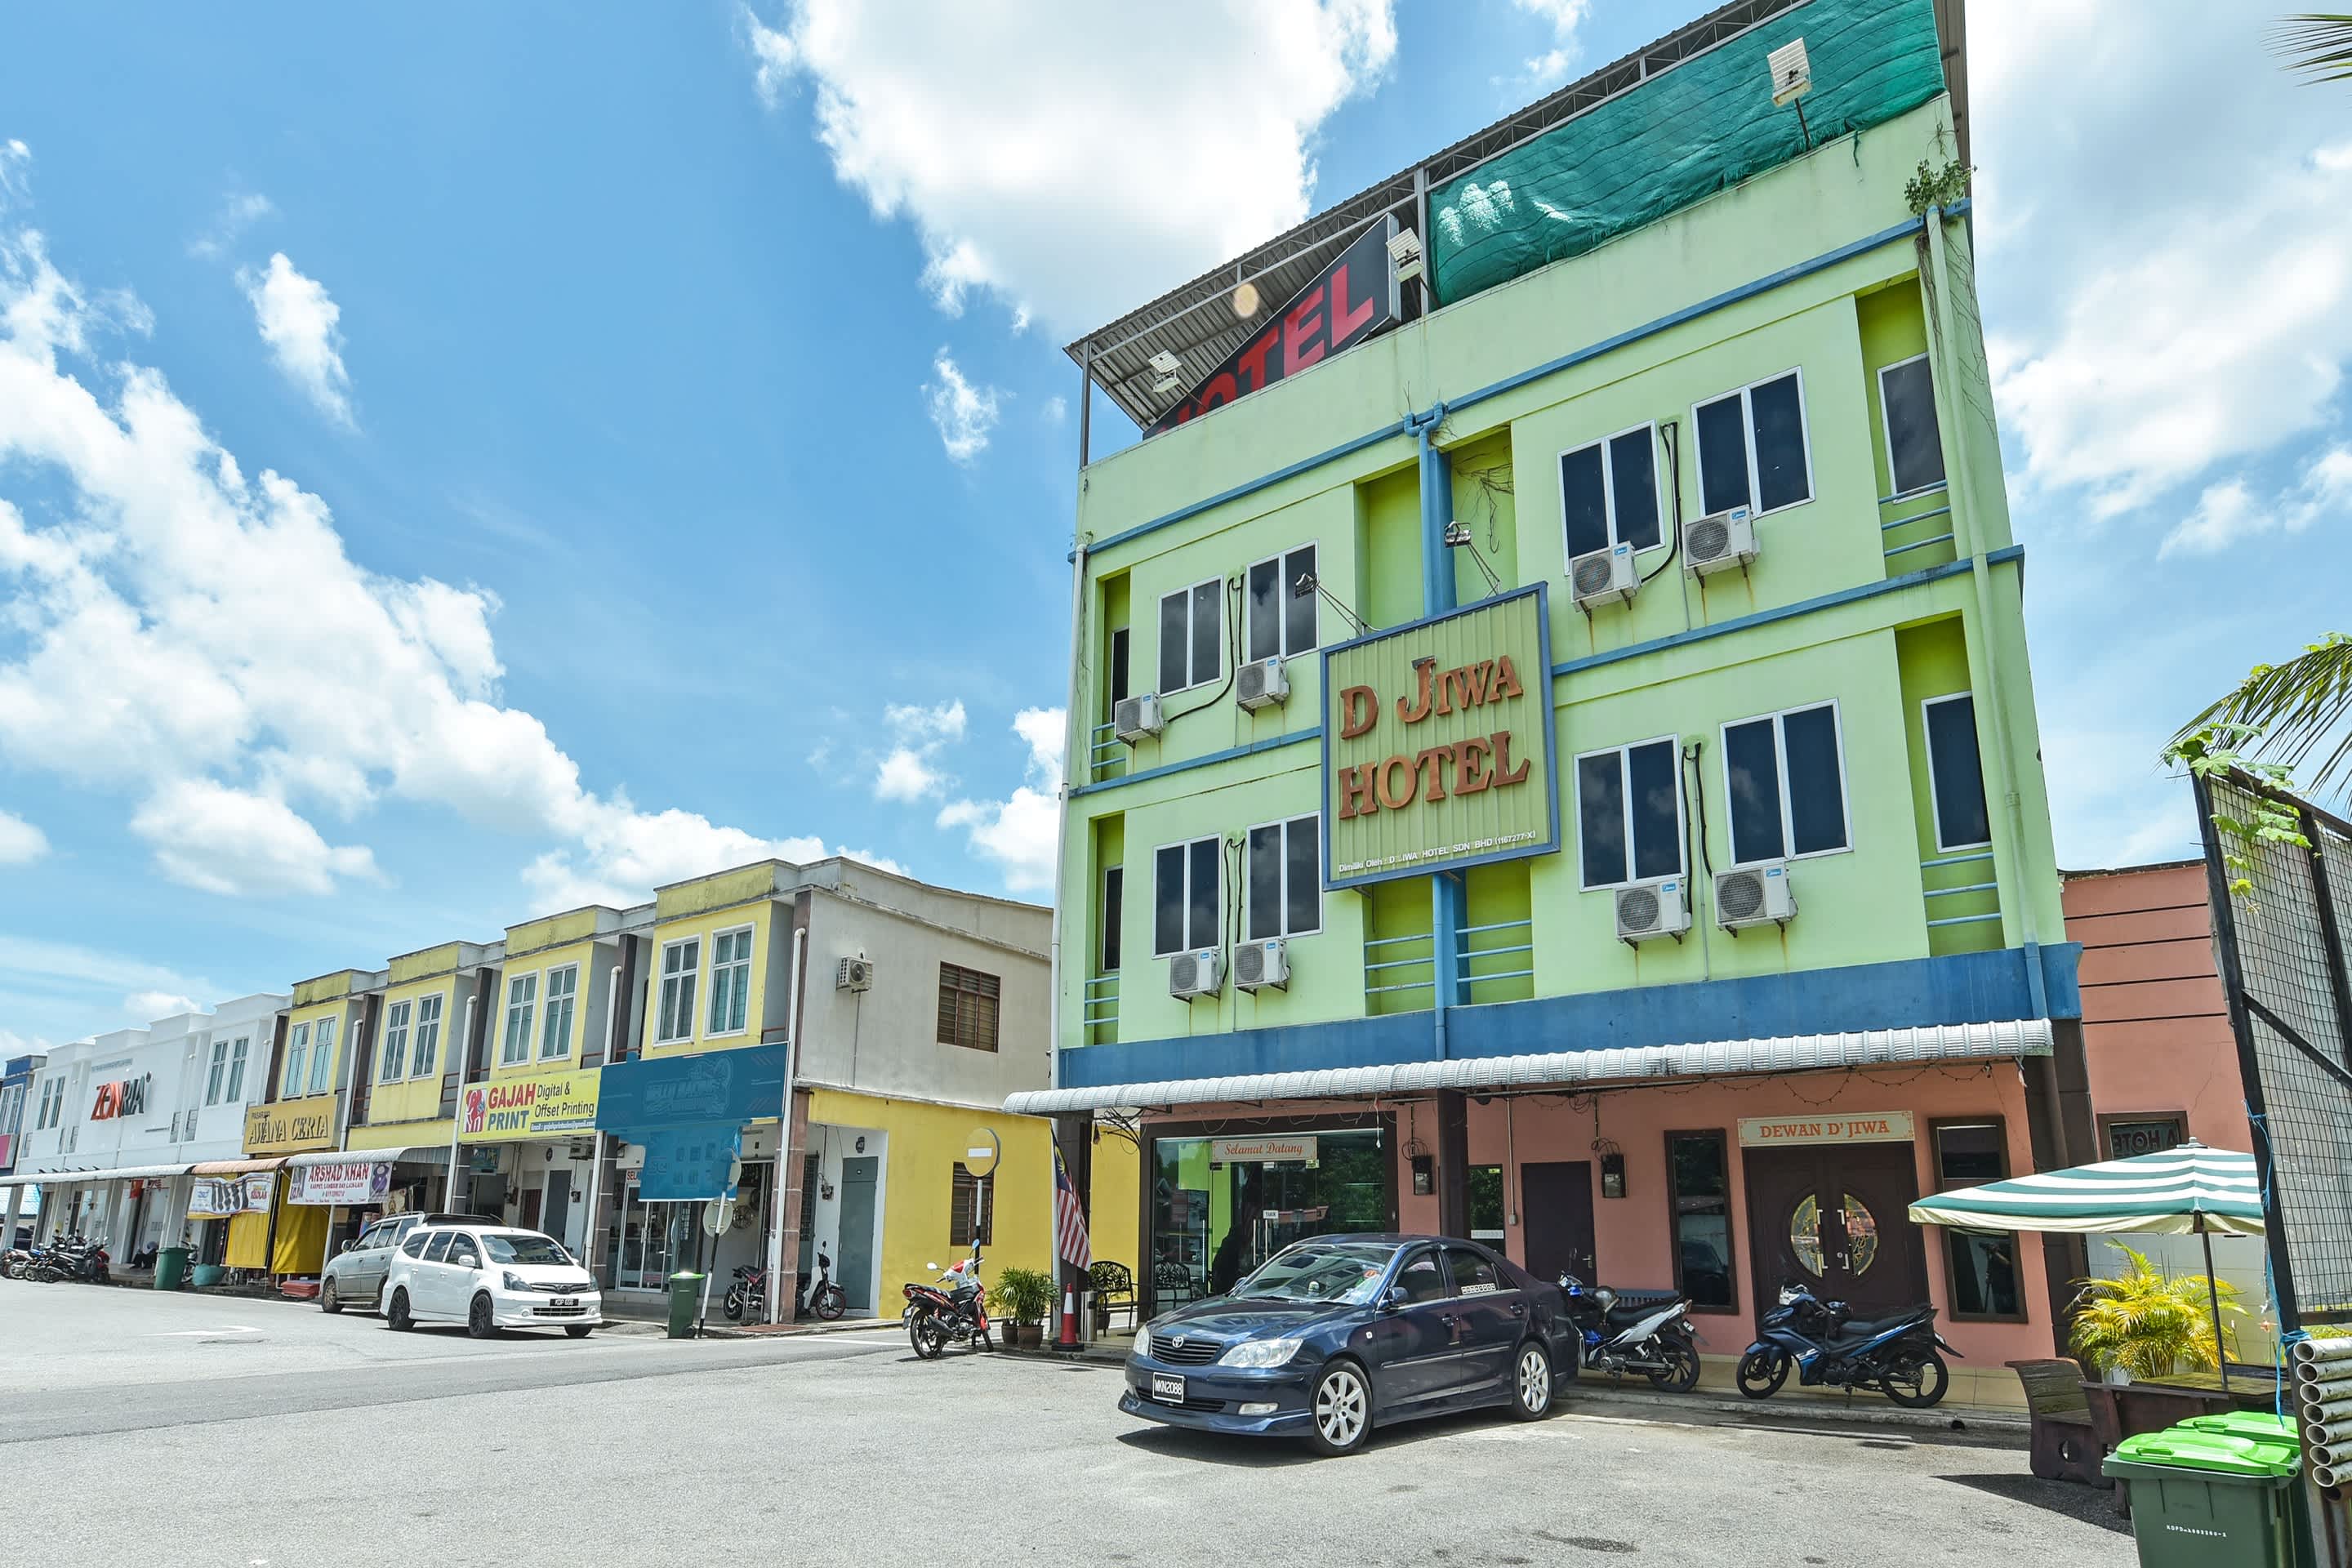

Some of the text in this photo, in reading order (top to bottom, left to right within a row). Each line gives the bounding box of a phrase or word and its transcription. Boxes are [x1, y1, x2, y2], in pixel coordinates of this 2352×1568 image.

[1340, 684, 1379, 740] D
[1338, 730, 1530, 820] HOTEL
[1389, 855, 1396, 863] D
[1423, 847, 1449, 858] HOTEL
[1454, 842, 1470, 853] SDN
[1475, 838, 1493, 849] BHD
[488, 1080, 570, 1110] GAJAH Digital &
[292, 1114, 328, 1141] CERIA
[488, 1100, 595, 1131] PRINT Offset Printing
[1760, 1124, 1822, 1138] DEWAN
[1225, 1142, 1303, 1156] Selamat Datang
[309, 1162, 369, 1183] ARSHAD KHAN
[1155, 1379, 1182, 1396] WKN2088
